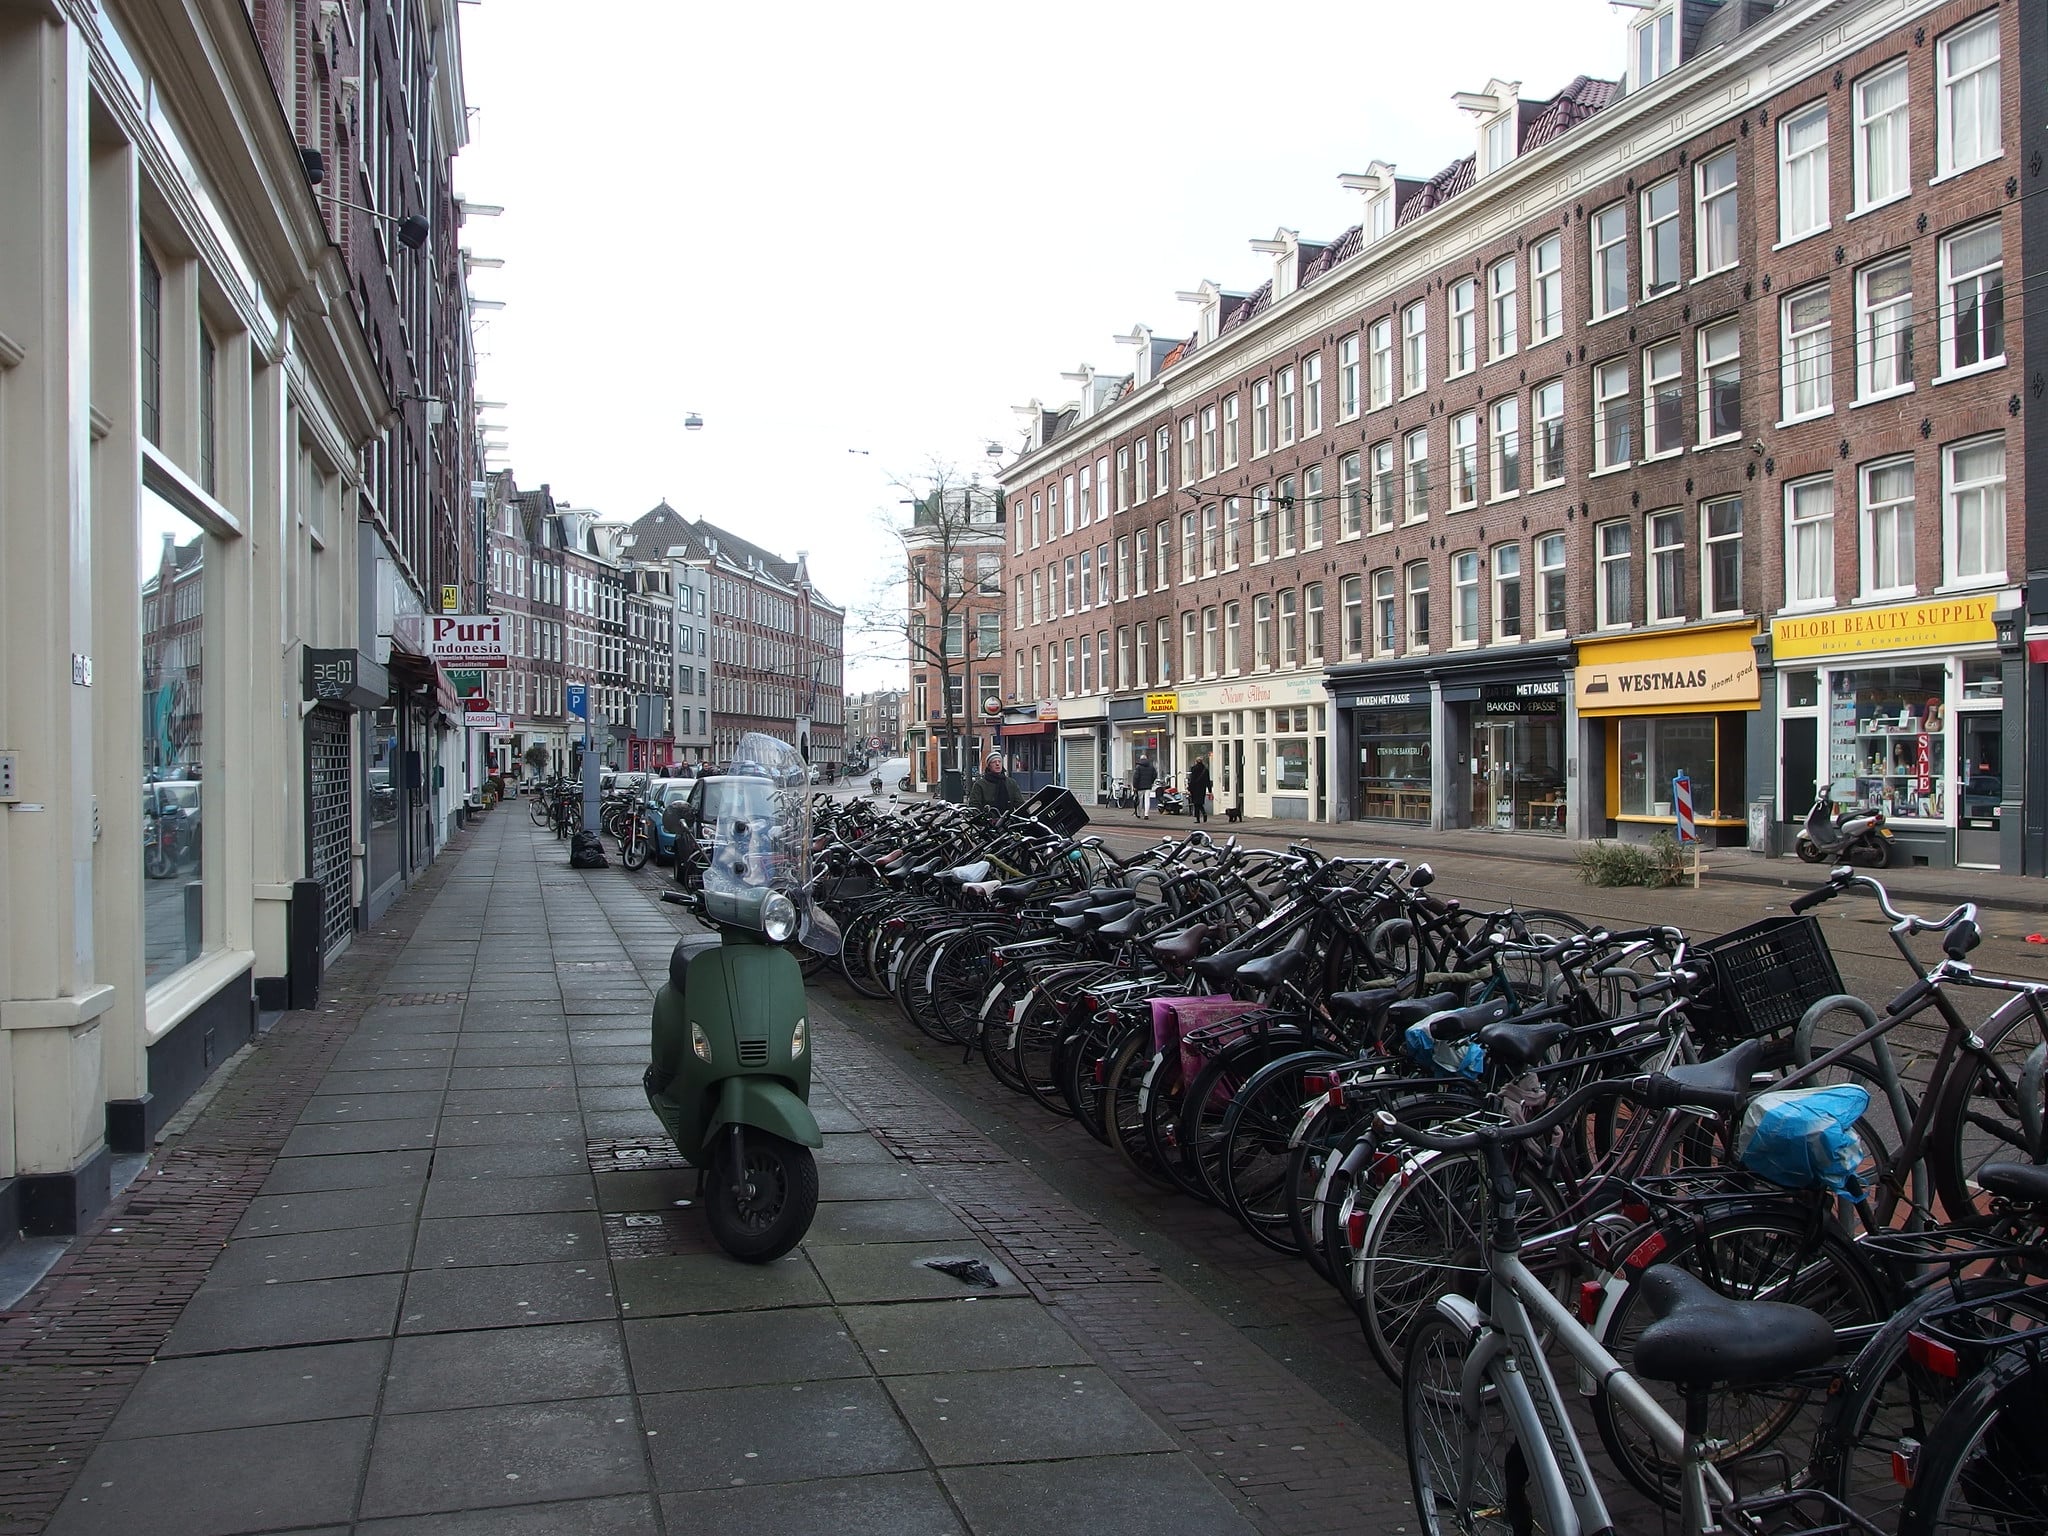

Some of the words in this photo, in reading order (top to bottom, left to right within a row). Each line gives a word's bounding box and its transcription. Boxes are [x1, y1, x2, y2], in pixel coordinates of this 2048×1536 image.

[432, 617, 501, 641] Puri
[1780, 620, 1836, 640] MILOBI
[1844, 611, 1910, 633] BEAUTY
[1917, 602, 1988, 626] SUPPLY
[432, 643, 501, 654] Indonesia
[1822, 640, 1848, 650] Hair
[1871, 633, 1938, 645] Cosmetics
[1618, 669, 1707, 692] WESTMAAS
[1736, 661, 1753, 683] goed
[1516, 684, 1532, 696] MET
[1533, 682, 1559, 695] PASSIE
[572, 696, 580, 708] P
[1356, 696, 1378, 706] BAKKEN
[1379, 695, 1390, 705] MET
[1391, 693, 1410, 704] PASSIE
[1486, 702, 1520, 711] BAKKEN
[1918, 735, 1929, 790] SALE
[1510, 1334, 1587, 1498] FORMULA
